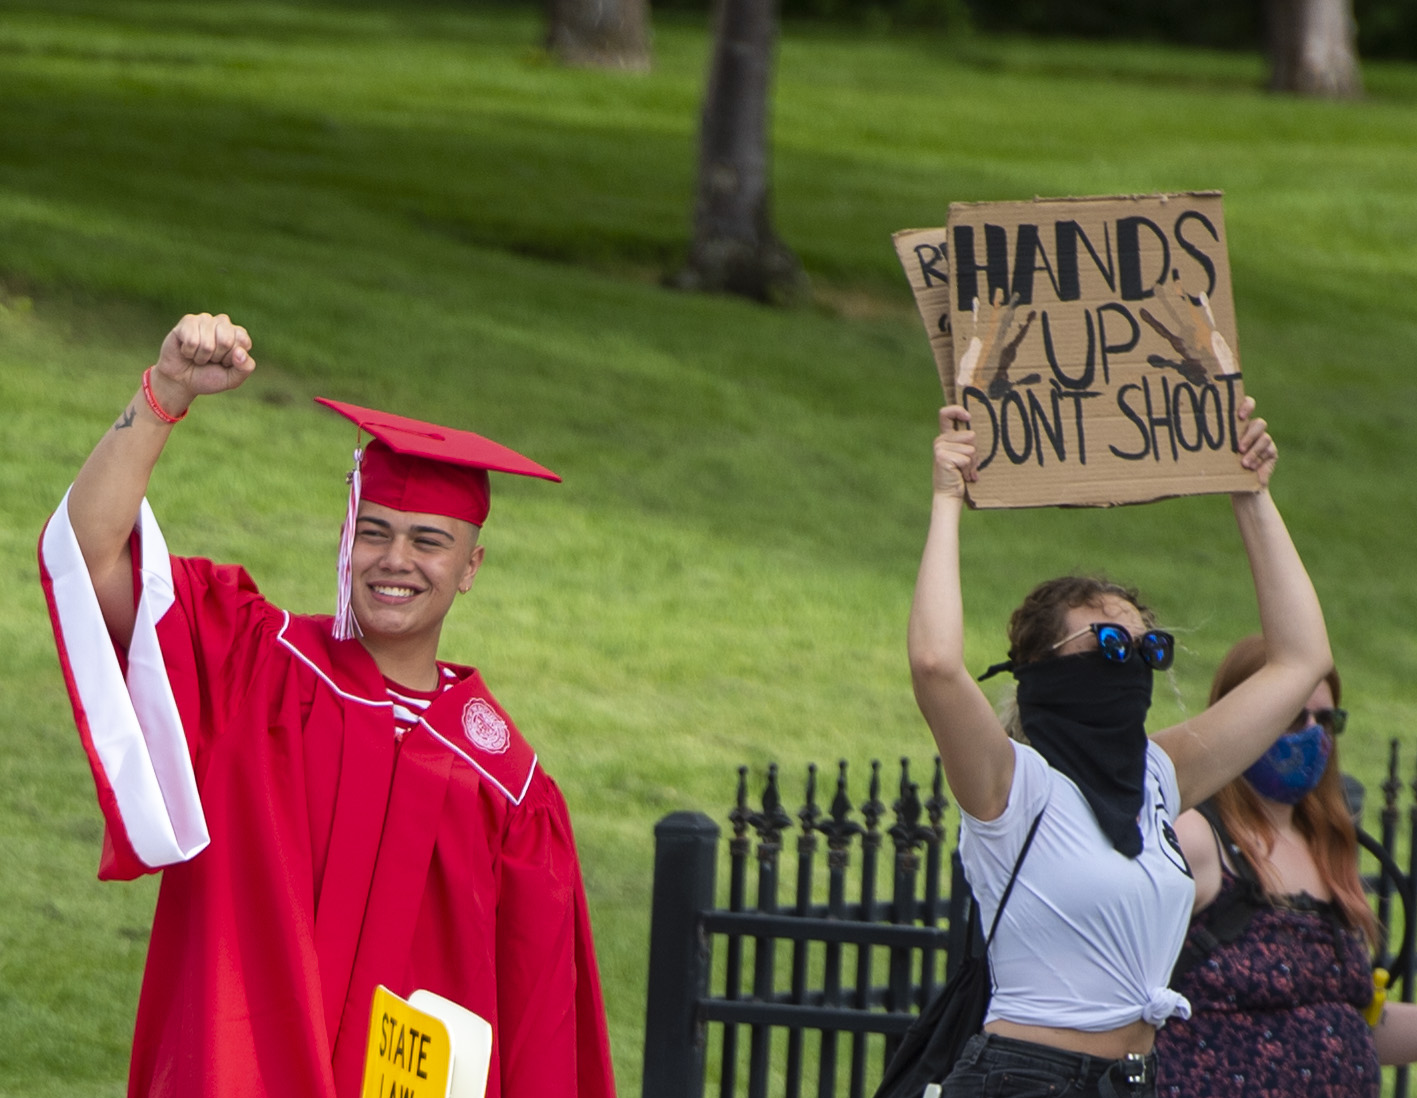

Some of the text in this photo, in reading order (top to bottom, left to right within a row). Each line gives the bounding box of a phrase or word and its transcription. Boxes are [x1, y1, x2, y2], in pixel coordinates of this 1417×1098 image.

[953, 210, 1220, 312] HANDS
[1041, 302, 1141, 389] UP
[1108, 372, 1242, 462] SHOOT
[379, 1012, 431, 1079] STATE
